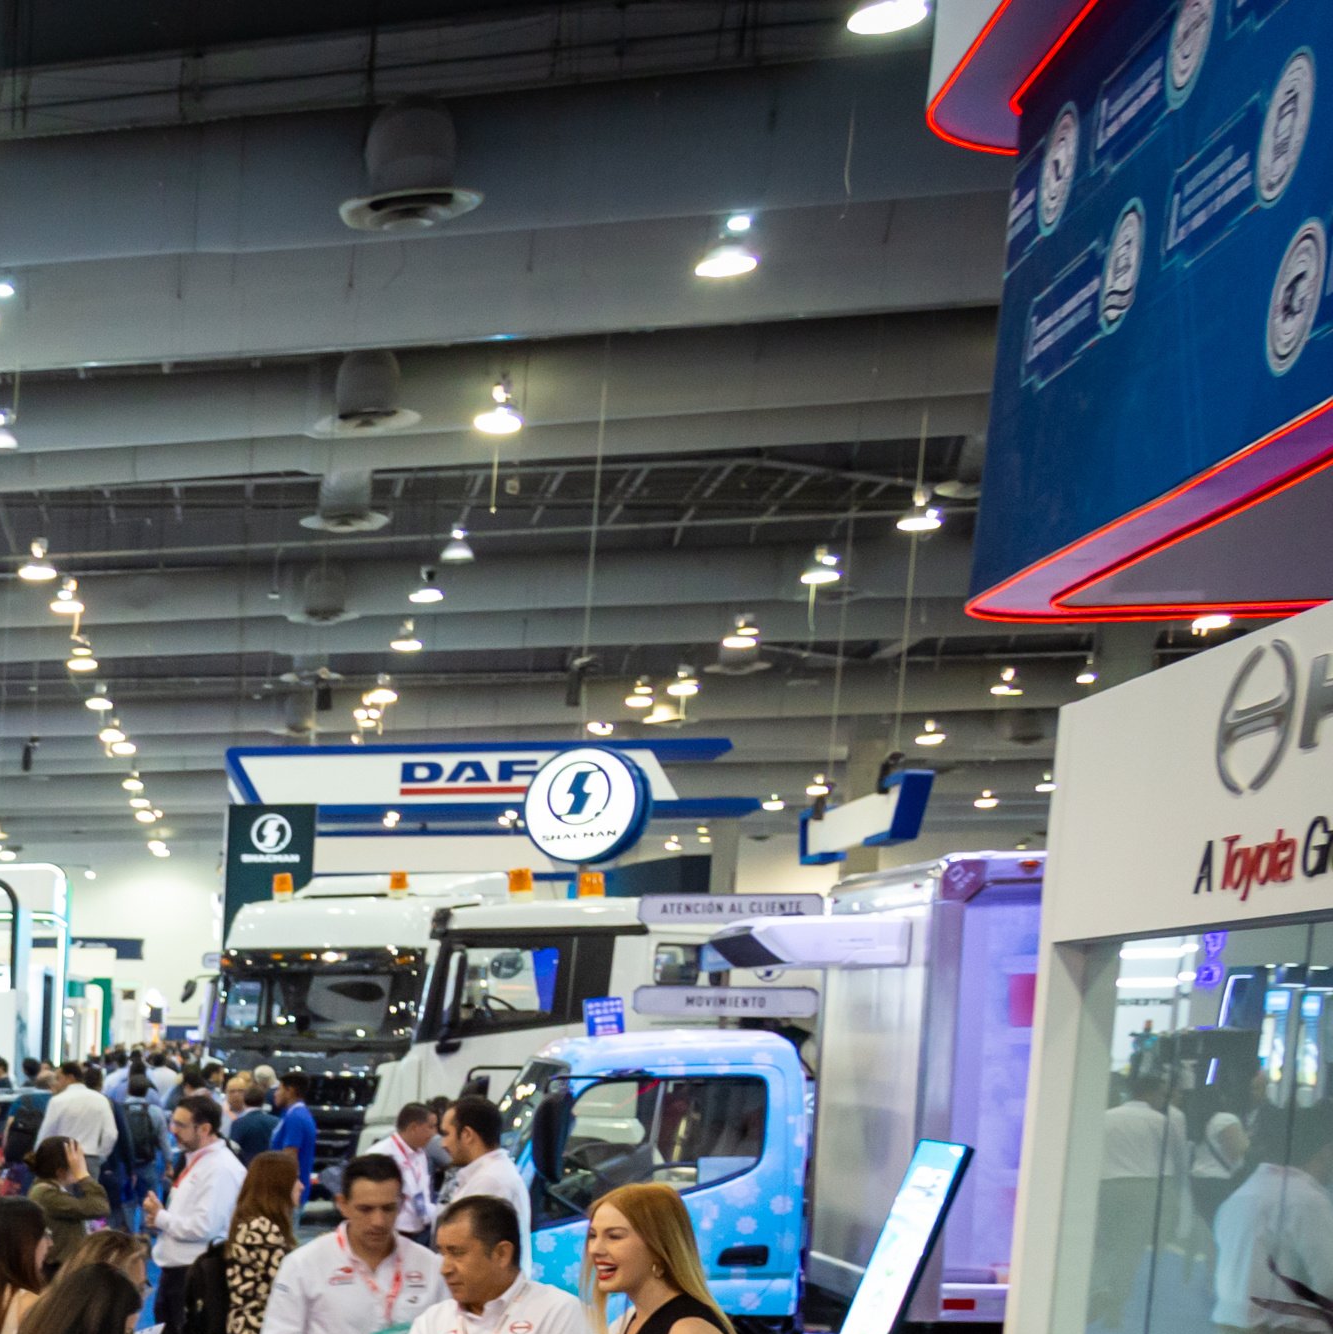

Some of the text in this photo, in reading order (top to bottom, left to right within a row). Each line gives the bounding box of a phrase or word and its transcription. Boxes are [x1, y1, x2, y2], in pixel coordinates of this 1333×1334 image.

[401, 759, 538, 784] DAF
[541, 829, 617, 843] SHACMAN
[241, 853, 300, 864] SHACMAN
[1193, 840, 1214, 895] A
[1221, 829, 1298, 902] Toyota
[661, 900, 803, 914] ATENCIÓN AL CLIENTE
[686, 996, 766, 1009] MOVIMIENTO
